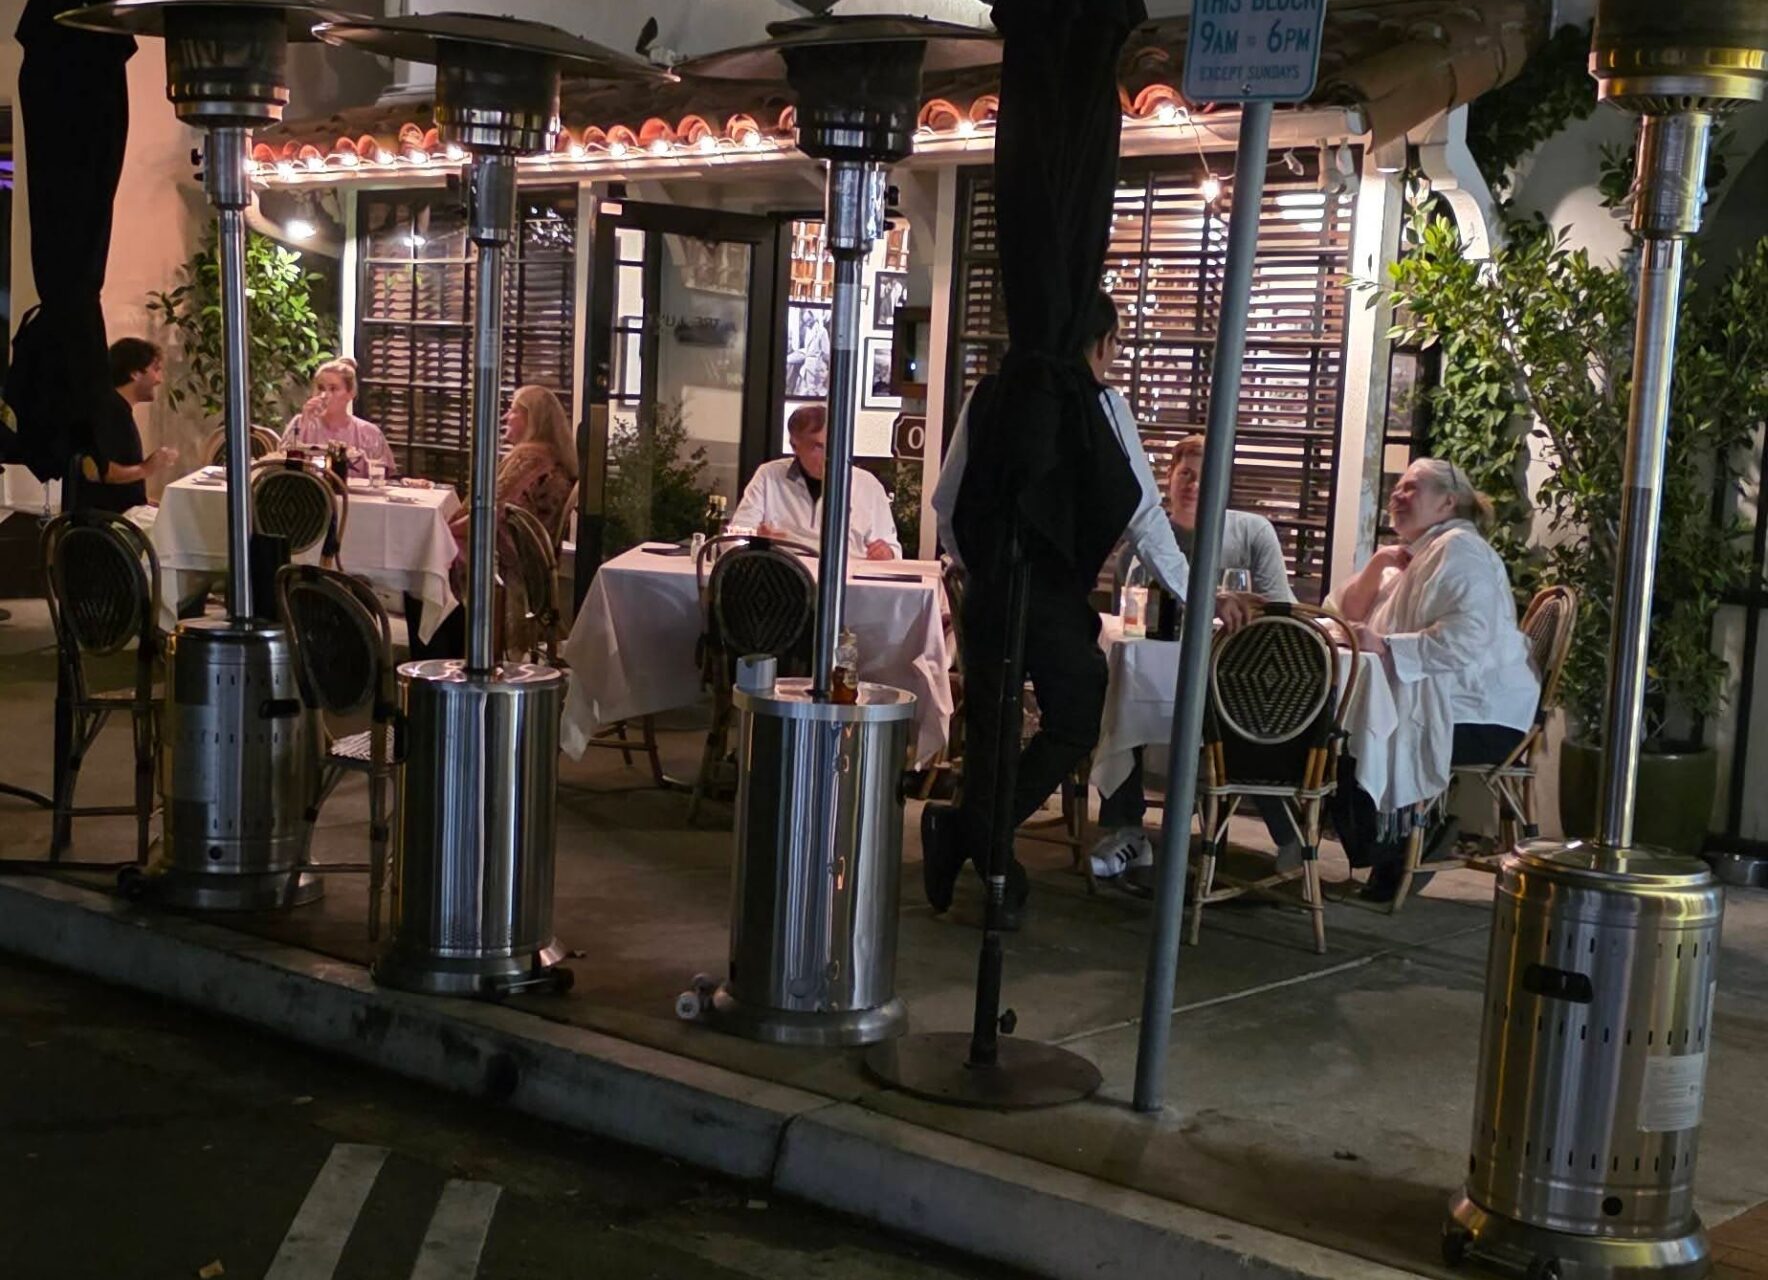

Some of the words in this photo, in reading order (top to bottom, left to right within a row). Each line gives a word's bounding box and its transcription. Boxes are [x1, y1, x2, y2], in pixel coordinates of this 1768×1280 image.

[1201, 21, 1239, 54] 9AM
[1267, 18, 1311, 53] 6PM
[1199, 65, 1243, 81] EXCEPT
[1247, 64, 1300, 81] SUNDAYS
